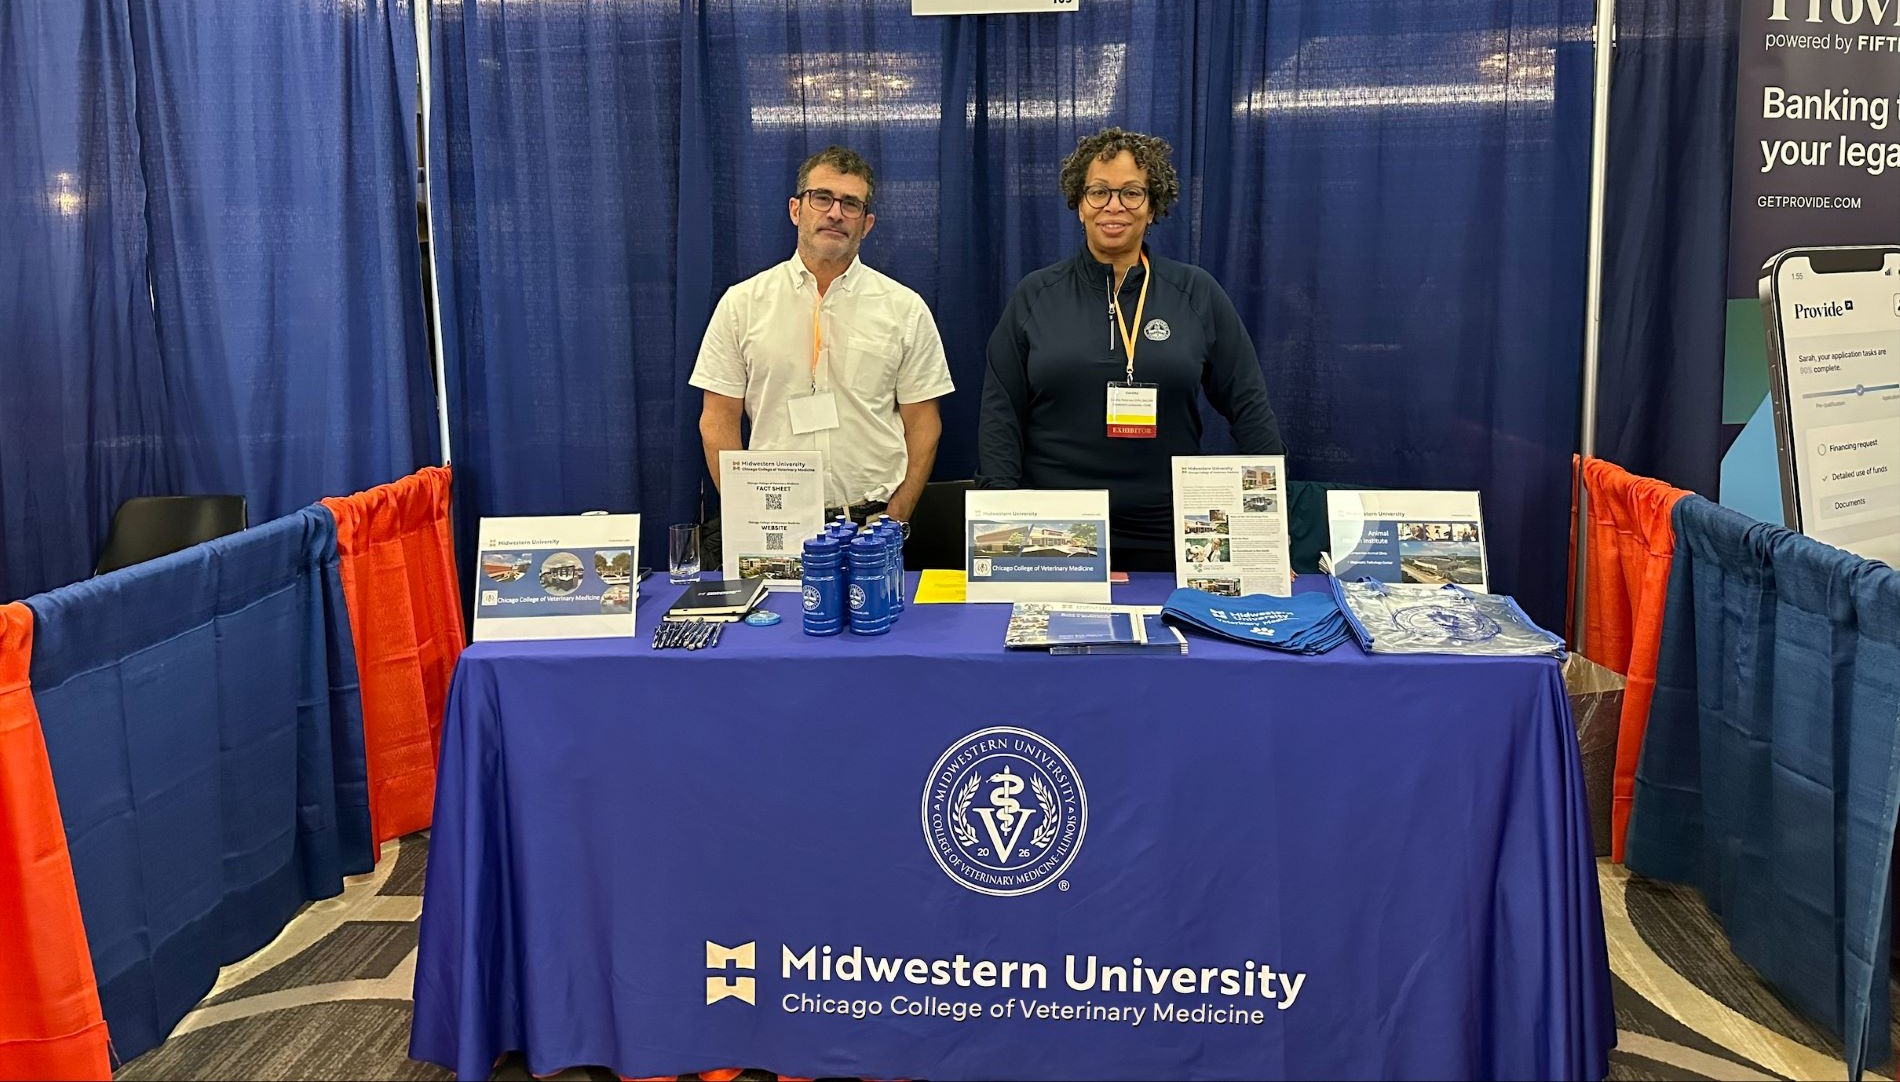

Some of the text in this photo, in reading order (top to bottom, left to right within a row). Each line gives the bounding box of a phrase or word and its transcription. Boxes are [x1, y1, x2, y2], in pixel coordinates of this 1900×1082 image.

[1765, 33, 1900, 54] powered by FIFT
[1763, 86, 1889, 130] Banking
[1760, 139, 1832, 173] your
[1757, 195, 1861, 209] GETPROVIDE.COM
[1794, 301, 1844, 319] Provide
[1798, 354, 1817, 363] Sarah,
[1818, 354, 1830, 362] your
[1831, 351, 1862, 361] application
[1863, 349, 1877, 357] tasks
[1829, 439, 1878, 452] Financing request
[1832, 470, 1855, 481] Detailed
[1867, 467, 1872, 475] of
[1872, 465, 1888, 474] funds
[1834, 499, 1866, 510] Documents
[519, 596, 539, 604] College
[546, 595, 574, 603] Veterinary
[934, 738, 1076, 804] MIDWESTERN UNIVERSITY
[932, 813, 953, 857] COLLEGE
[948, 853, 963, 869] OF
[959, 864, 1015, 886] VETERINARY
[977, 847, 1030, 858] 20 26
[782, 943, 1307, 1011] Midwestern University
[782, 992, 1265, 1026] Chicago College of Veterinary Medicine
